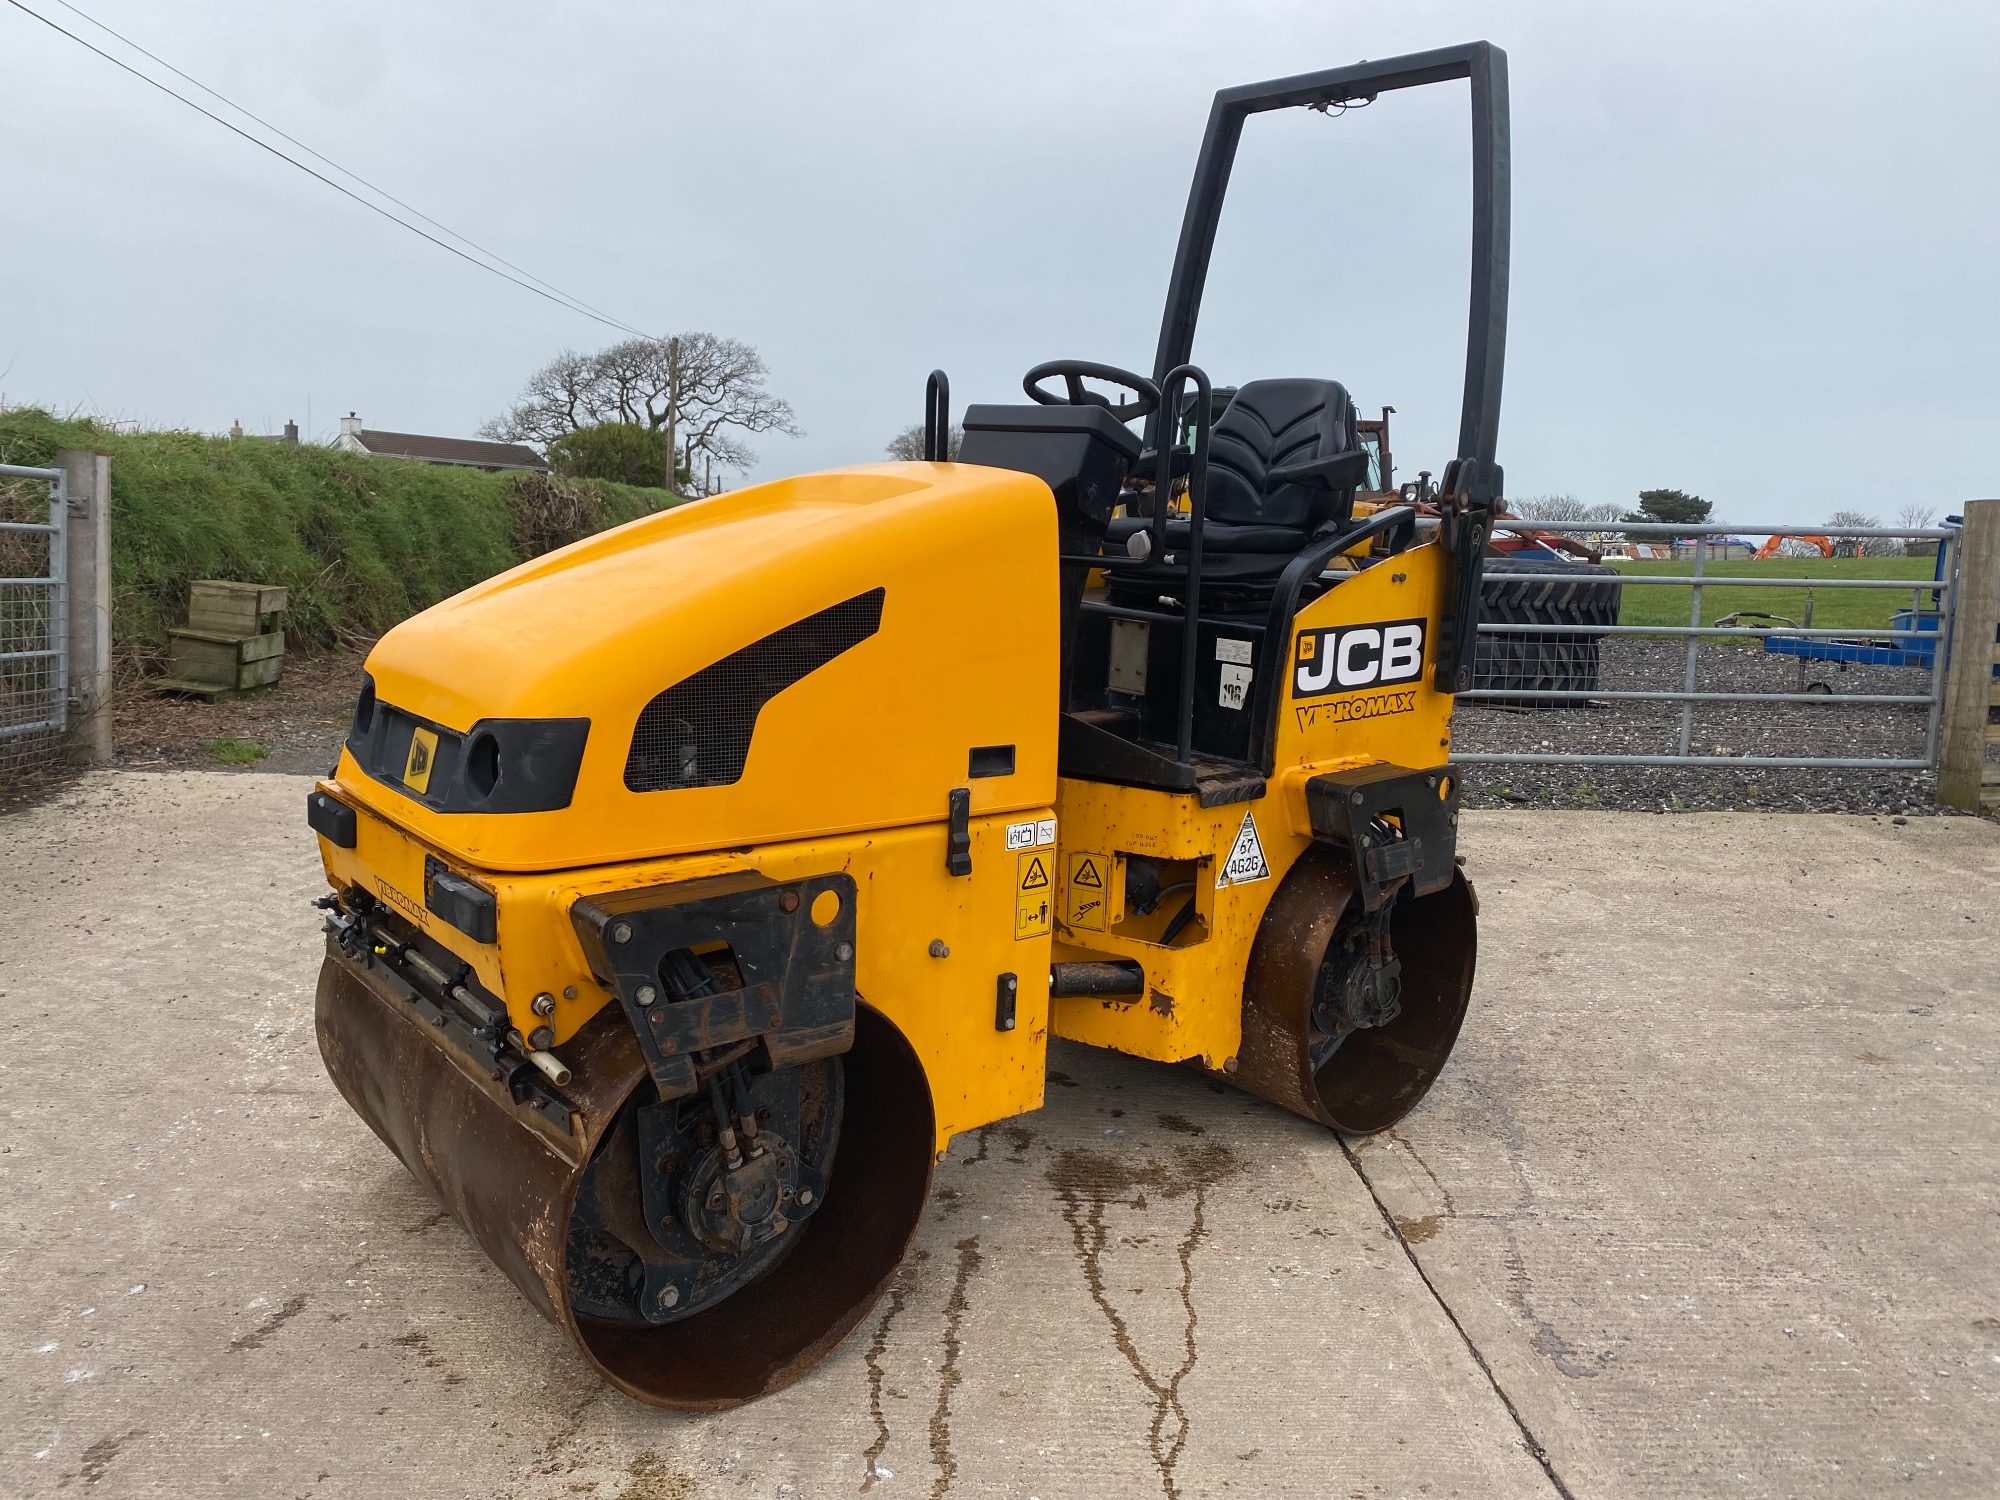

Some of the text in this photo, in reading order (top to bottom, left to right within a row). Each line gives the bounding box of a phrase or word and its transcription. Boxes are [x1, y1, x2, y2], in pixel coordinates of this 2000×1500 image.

[1297, 624, 1423, 692] JCB
[411, 738, 428, 775] JCB
[1240, 838, 1253, 855] 67
[1230, 856, 1259, 875] AG2G
[373, 874, 430, 928] VIBROMAX
